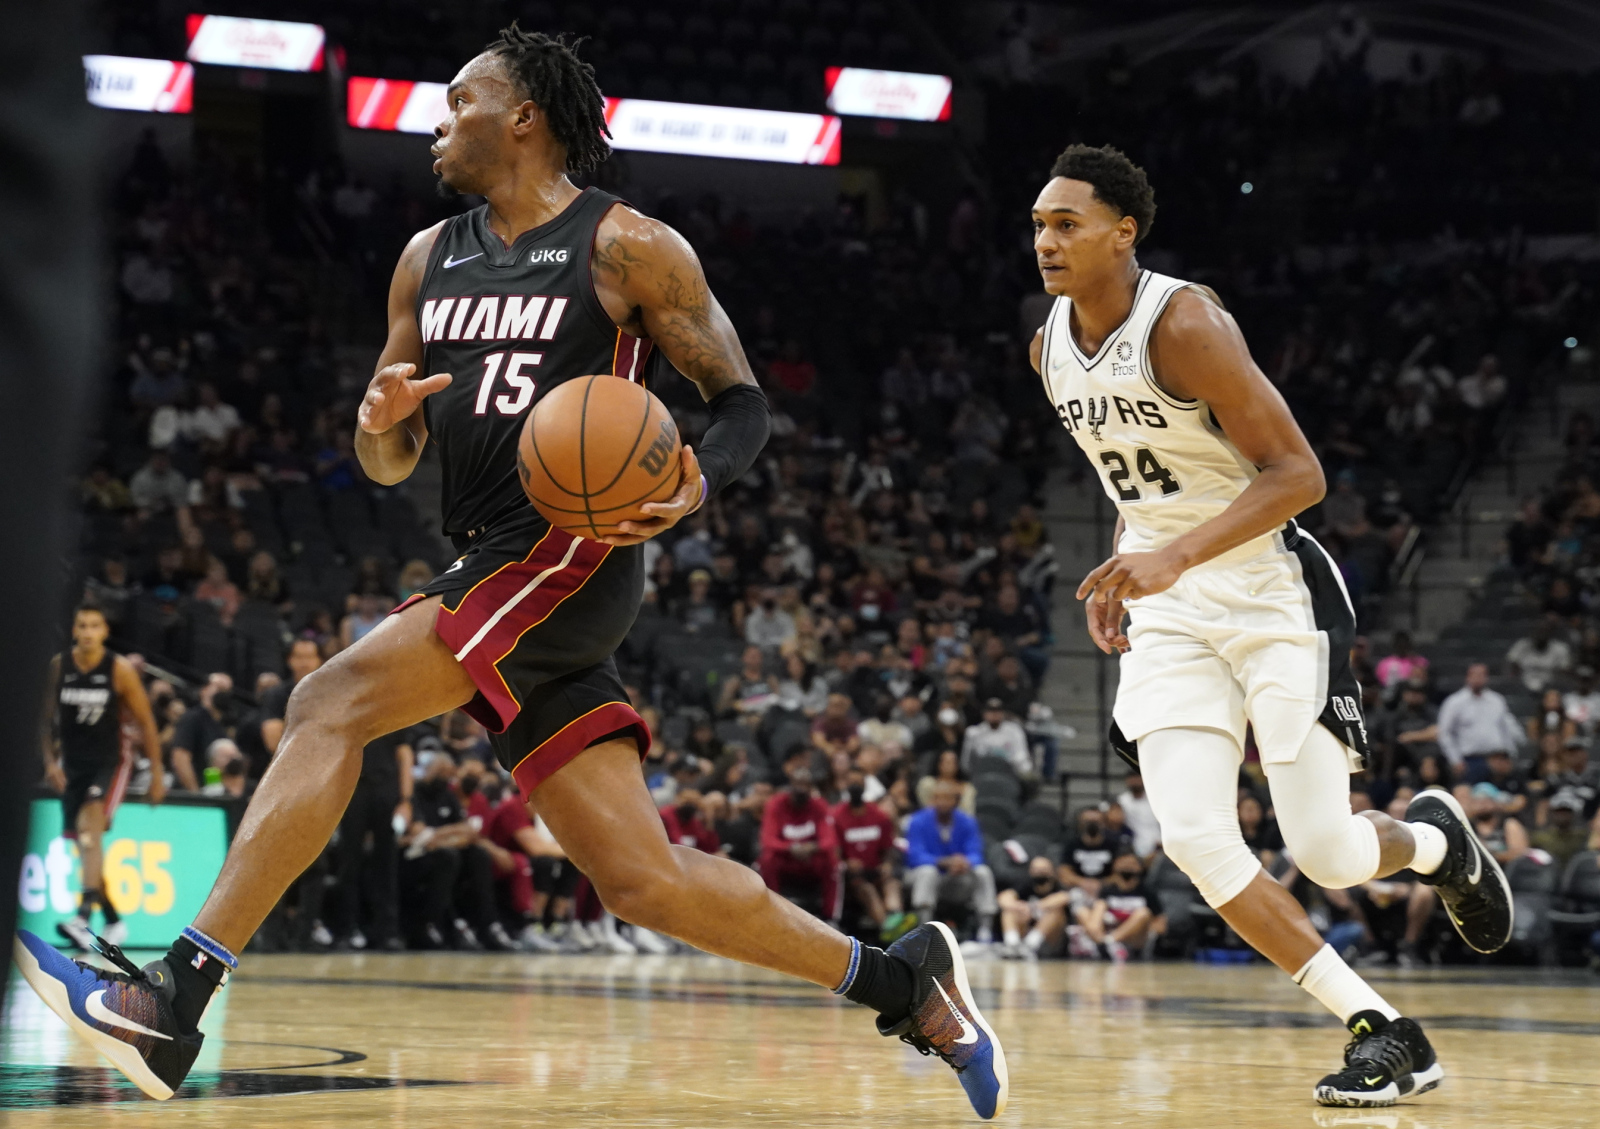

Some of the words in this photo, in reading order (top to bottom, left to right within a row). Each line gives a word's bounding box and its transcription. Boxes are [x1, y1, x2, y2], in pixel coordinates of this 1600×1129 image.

[531, 249, 567, 263] UKG
[421, 295, 570, 343] MIAMI
[473, 351, 546, 417] 15
[1112, 363, 1137, 376] Frost
[1057, 395, 1168, 435] SPURS
[637, 420, 677, 478] Wil
[1098, 446, 1183, 503] 24
